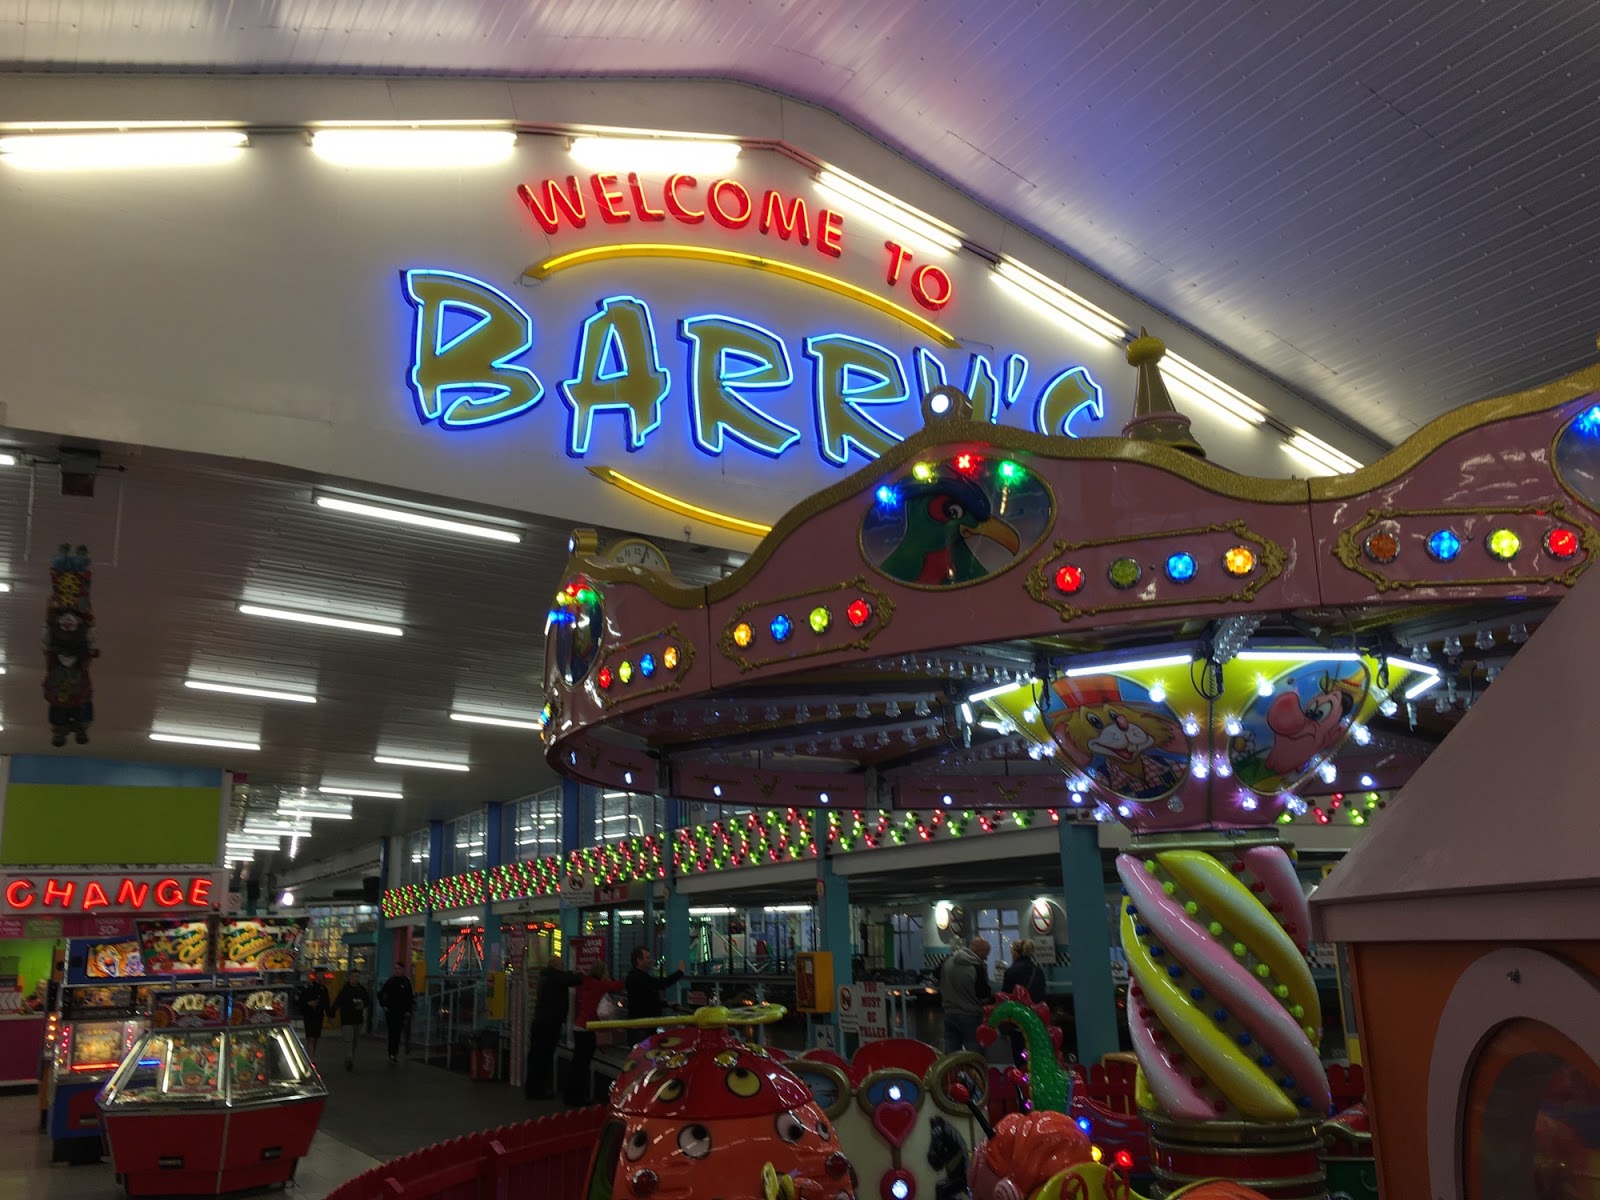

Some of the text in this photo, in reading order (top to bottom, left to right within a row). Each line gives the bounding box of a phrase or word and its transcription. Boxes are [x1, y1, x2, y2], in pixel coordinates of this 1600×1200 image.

[518, 172, 954, 311] WELCOME TO
[5, 878, 214, 911] CHANGE
[863, 980, 877, 993] YOU
[861, 995, 881, 1008] MUST
[867, 1011, 877, 1023] BE
